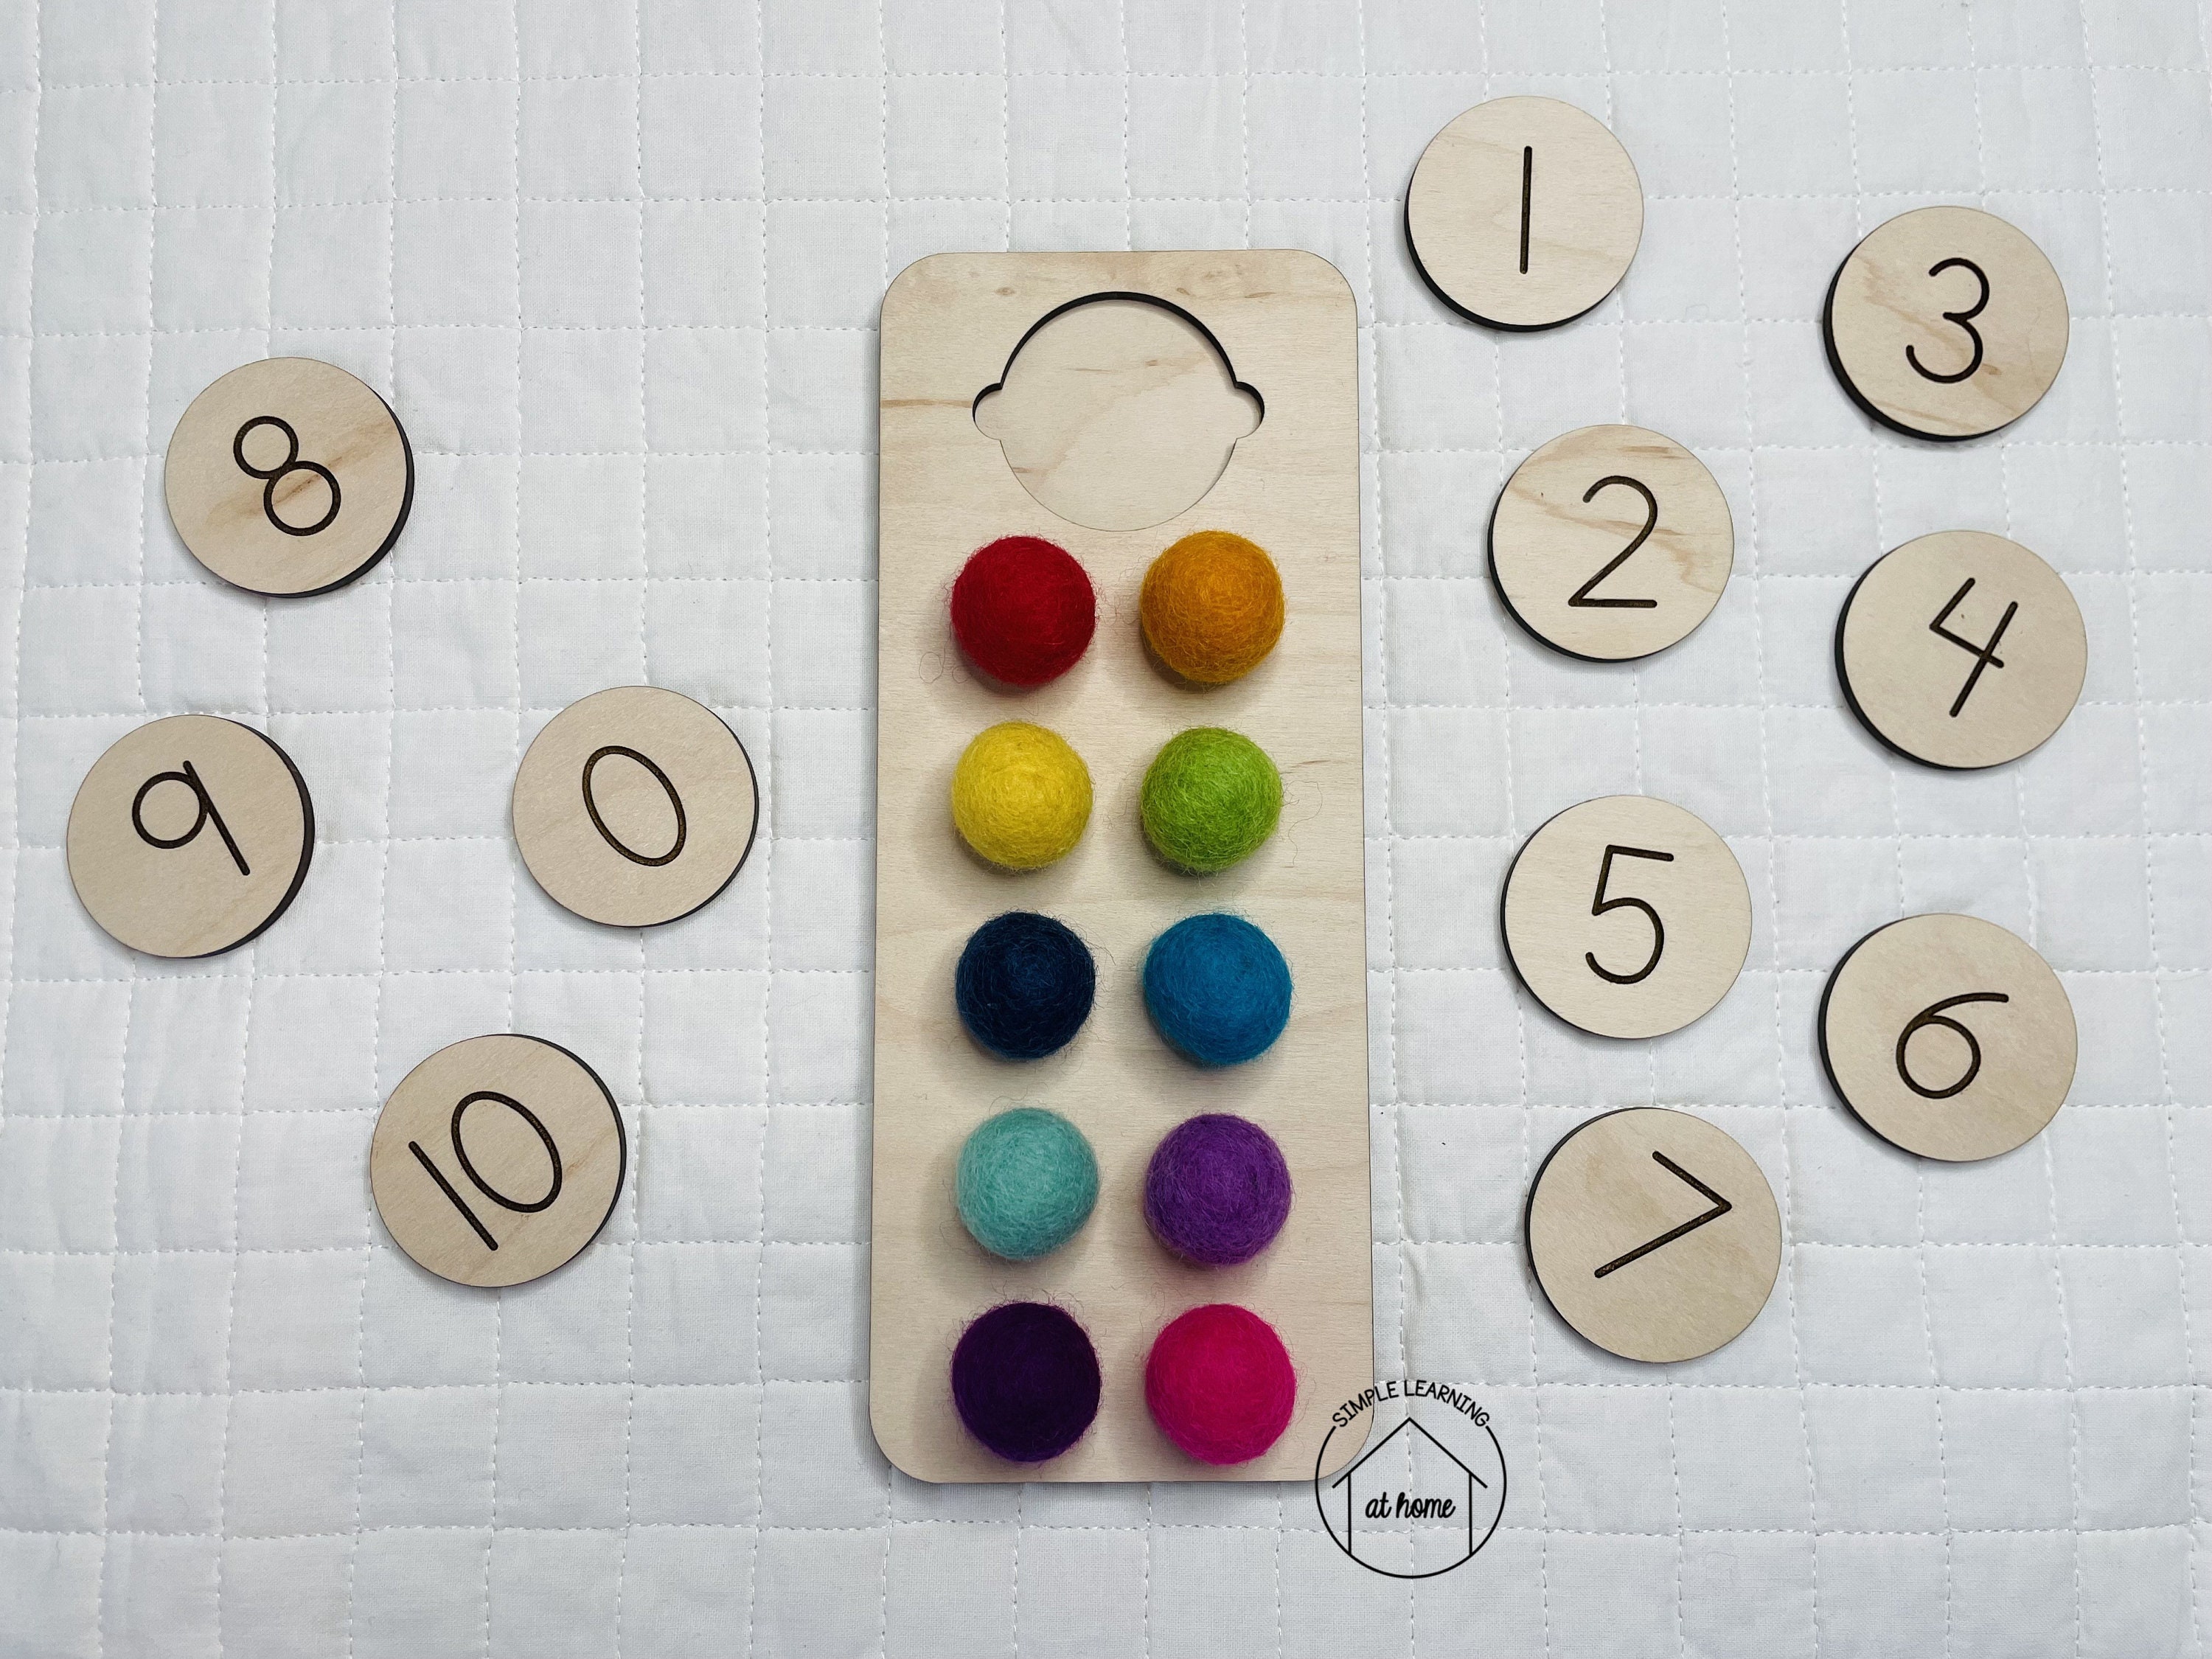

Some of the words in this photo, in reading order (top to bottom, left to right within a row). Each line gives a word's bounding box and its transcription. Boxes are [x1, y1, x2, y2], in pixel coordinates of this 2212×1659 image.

[1519, 145, 1533, 275] 1
[1905, 257, 1990, 384] 3
[232, 415, 341, 537] 8
[1568, 475, 1658, 608] 2
[1929, 577, 2018, 717] 4
[131, 760, 251, 877] 9
[582, 745, 687, 867] 0
[1585, 844, 1674, 985] 5
[1895, 992, 2009, 1100] 6
[408, 1091, 563, 1251] 10
[1593, 1150, 1733, 1279] 7
